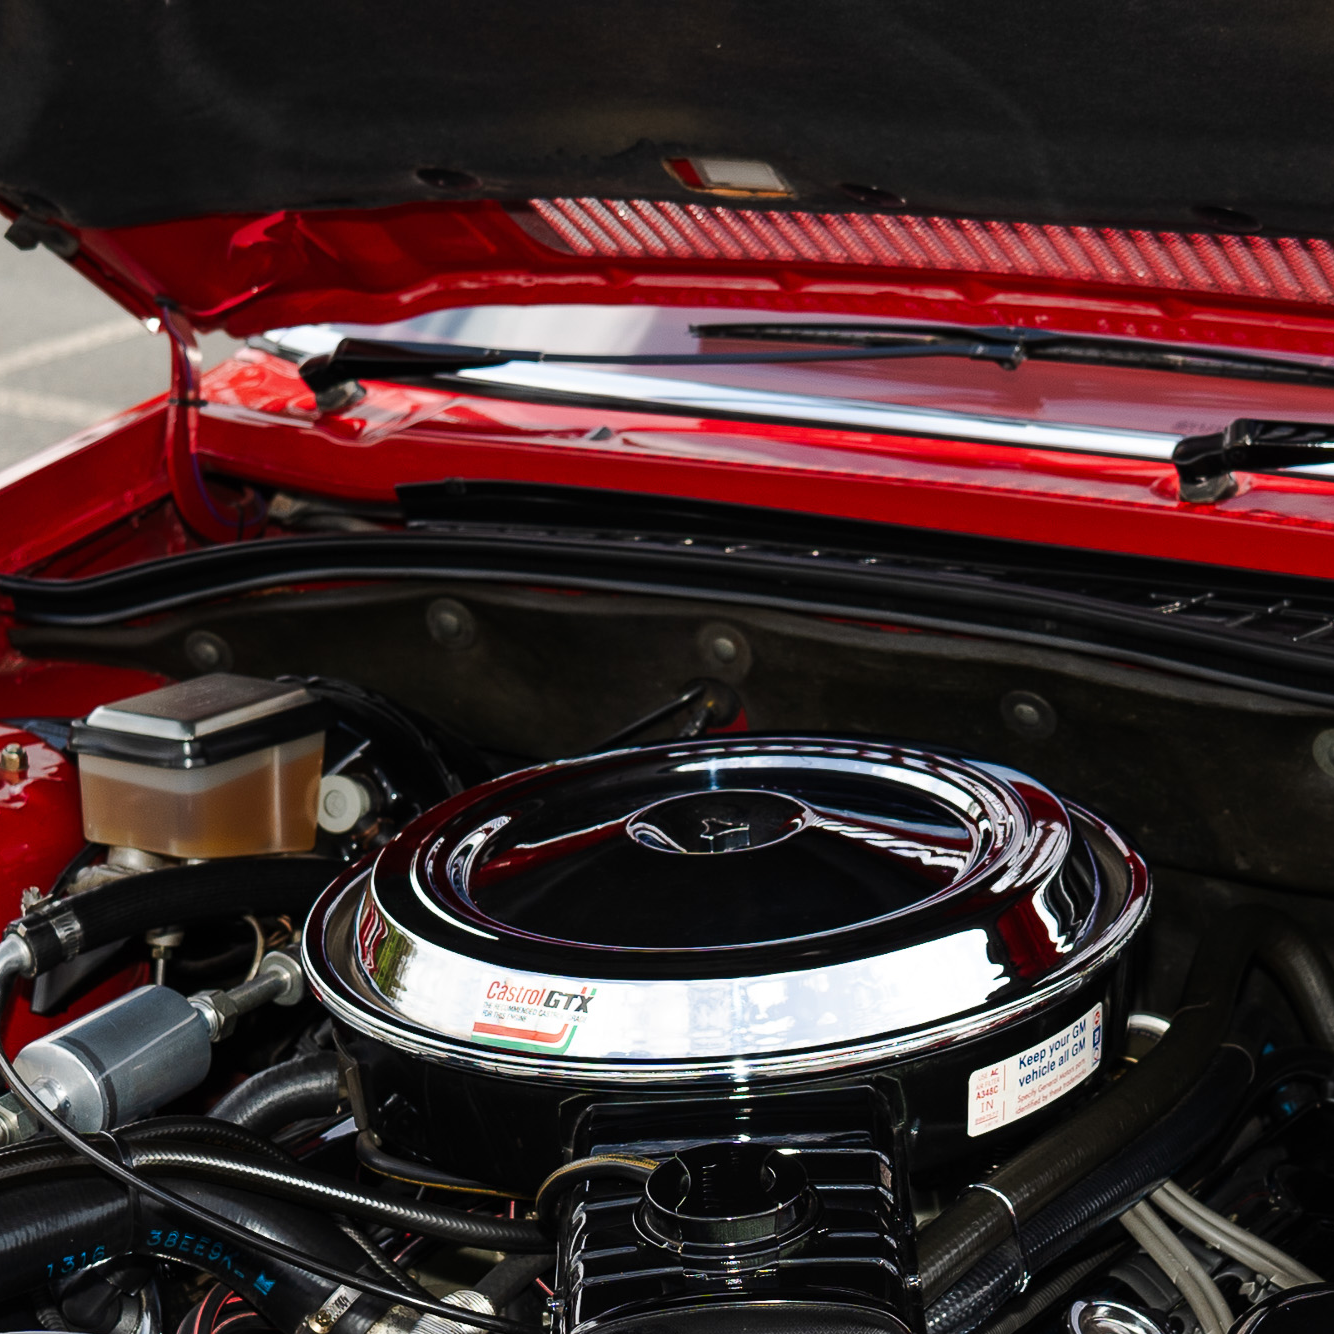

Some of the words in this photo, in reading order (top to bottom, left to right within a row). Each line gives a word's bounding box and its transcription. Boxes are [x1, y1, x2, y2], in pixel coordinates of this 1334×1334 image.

[487, 981, 546, 1006] Castrol
[544, 990, 594, 1013] GTX
[1019, 1048, 1046, 1070] Keep
[1049, 1033, 1070, 1058] your
[1072, 1020, 1086, 1040] GM
[1019, 1060, 1056, 1087] vehicle
[1058, 1050, 1069, 1067] all
[1071, 1038, 1086, 1057] GM
[991, 1068, 999, 1077] AC
